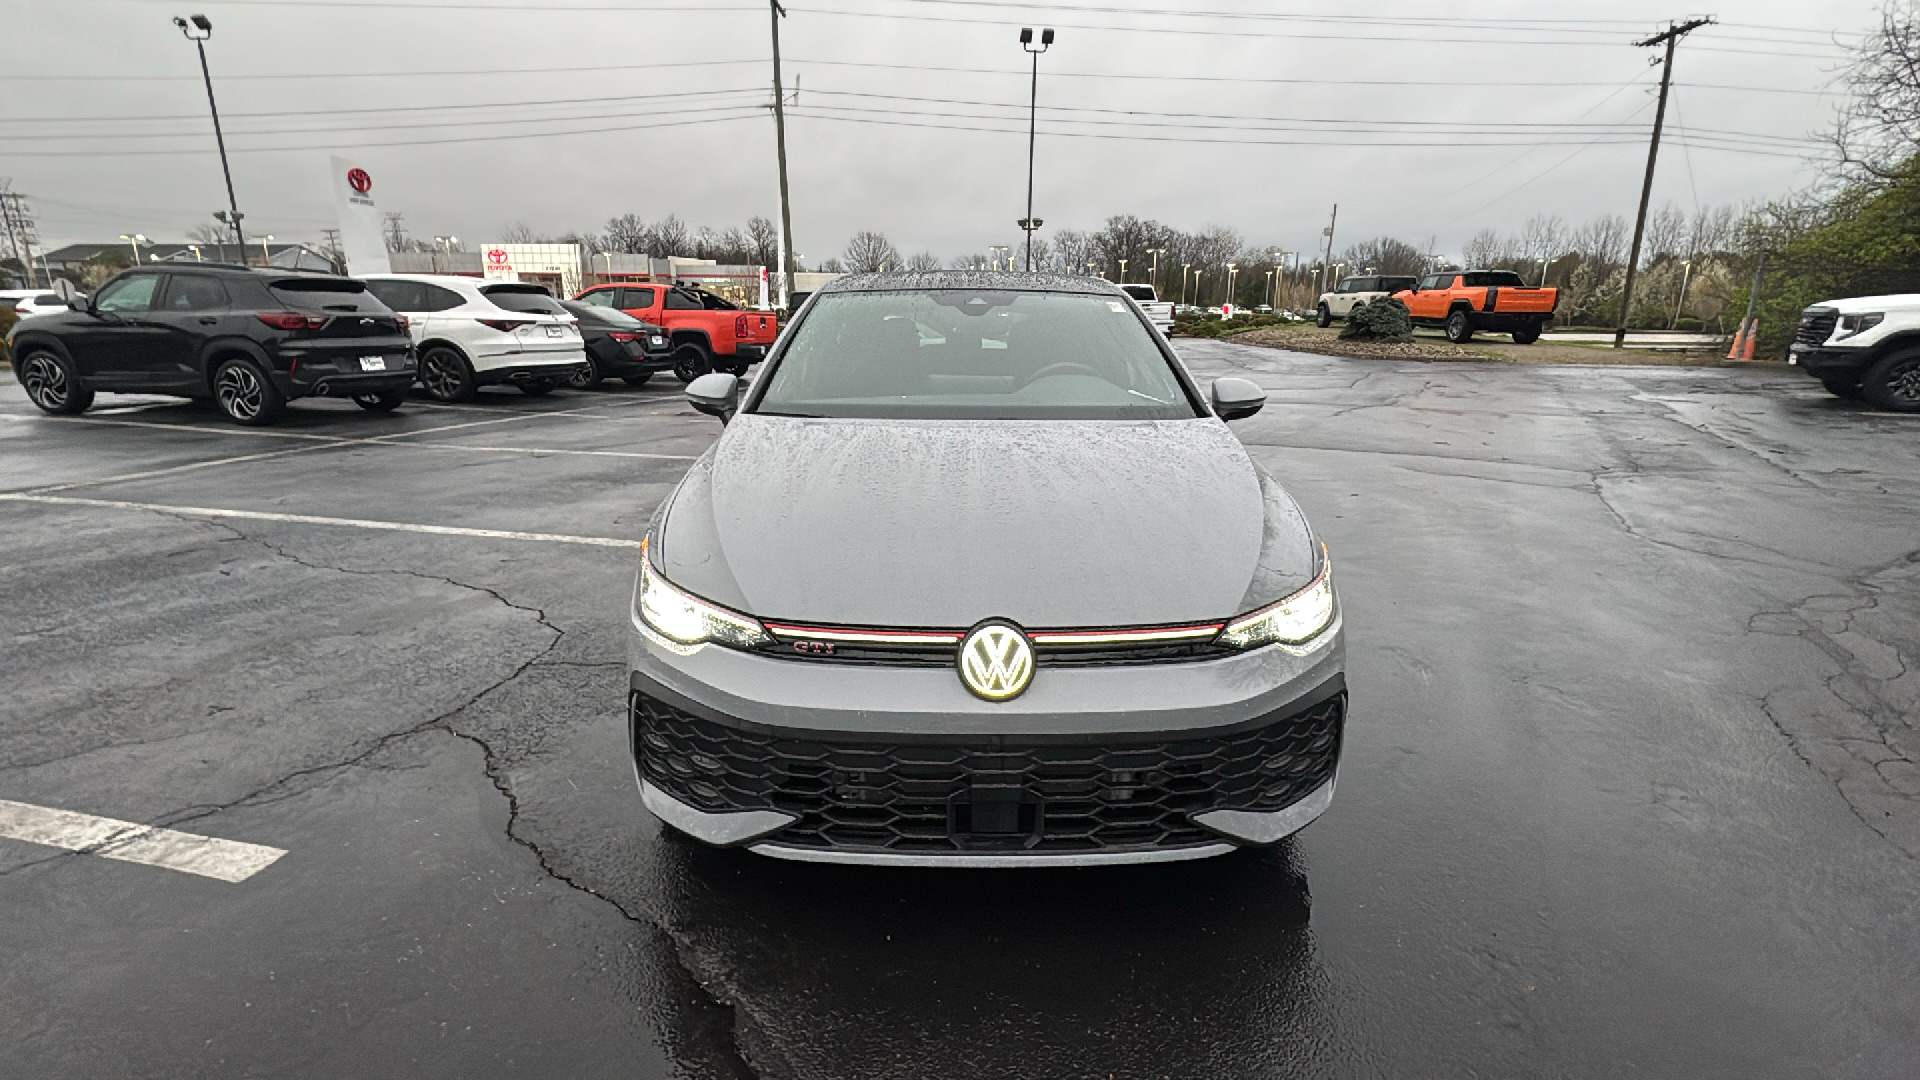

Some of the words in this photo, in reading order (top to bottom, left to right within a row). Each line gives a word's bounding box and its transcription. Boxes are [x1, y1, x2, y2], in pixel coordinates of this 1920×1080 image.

[487, 264, 513, 272] TOYOTA
[793, 641, 835, 655] GTI
[962, 625, 1032, 697] VW
